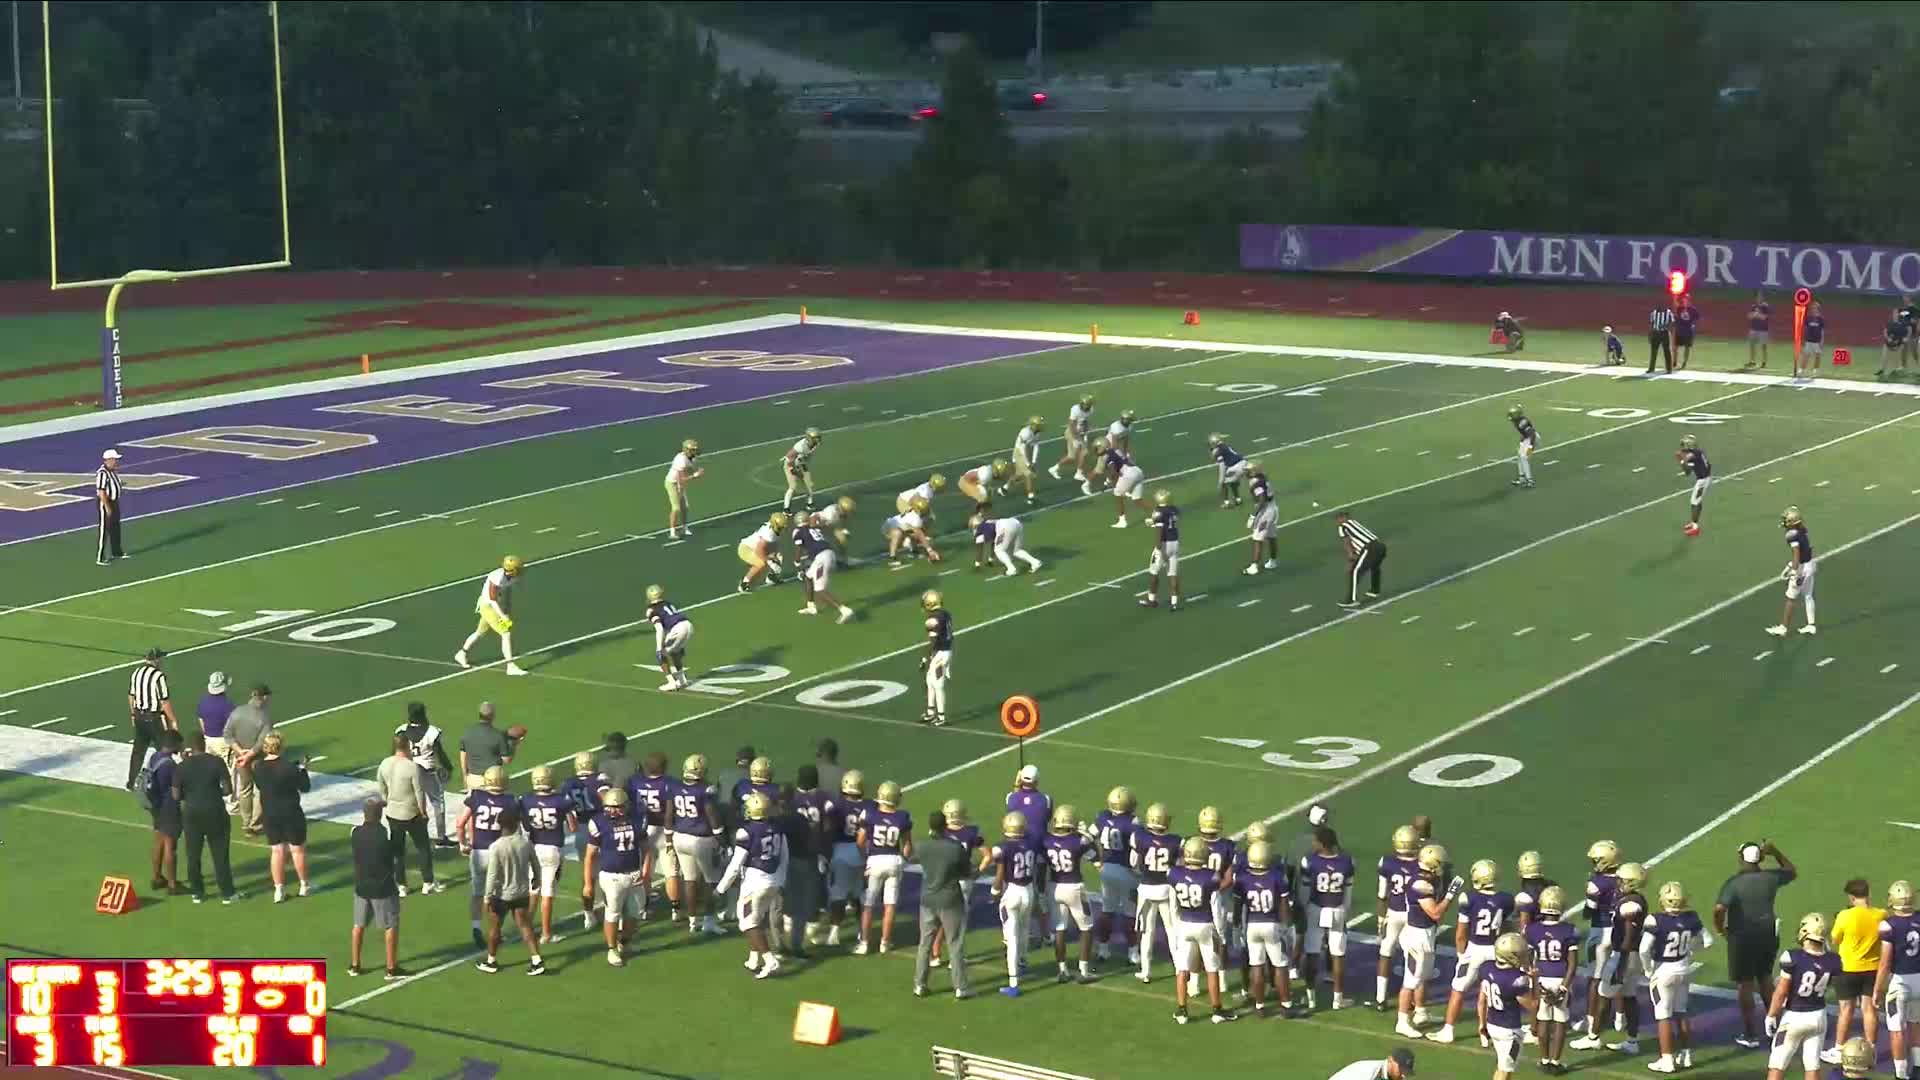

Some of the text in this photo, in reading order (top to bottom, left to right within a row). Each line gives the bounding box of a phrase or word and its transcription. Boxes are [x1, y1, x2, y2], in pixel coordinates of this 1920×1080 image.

[1489, 236, 1608, 279] MEN
[1627, 240, 1738, 285] FOR
[112, 328, 123, 408] CADETS
[219, 608, 397, 642] 10
[683, 663, 908, 708] 20
[1261, 736, 1524, 787] 30
[475, 805, 503, 830] 27
[528, 807, 557, 830] 35
[674, 795, 699, 818] 95
[614, 831, 635, 851] 77
[873, 824, 900, 847] 50
[1013, 851, 1035, 880] 29
[1047, 848, 1073, 873] 36
[1144, 847, 1170, 872] 42
[98, 880, 126, 910] 20
[1175, 882, 1202, 908] 28
[1316, 872, 1344, 894] 82
[1246, 889, 1273, 913] 30
[1476, 908, 1504, 936] 24
[1537, 940, 1562, 961] 16
[1663, 930, 1691, 958] 20
[1798, 971, 1831, 998] 84
